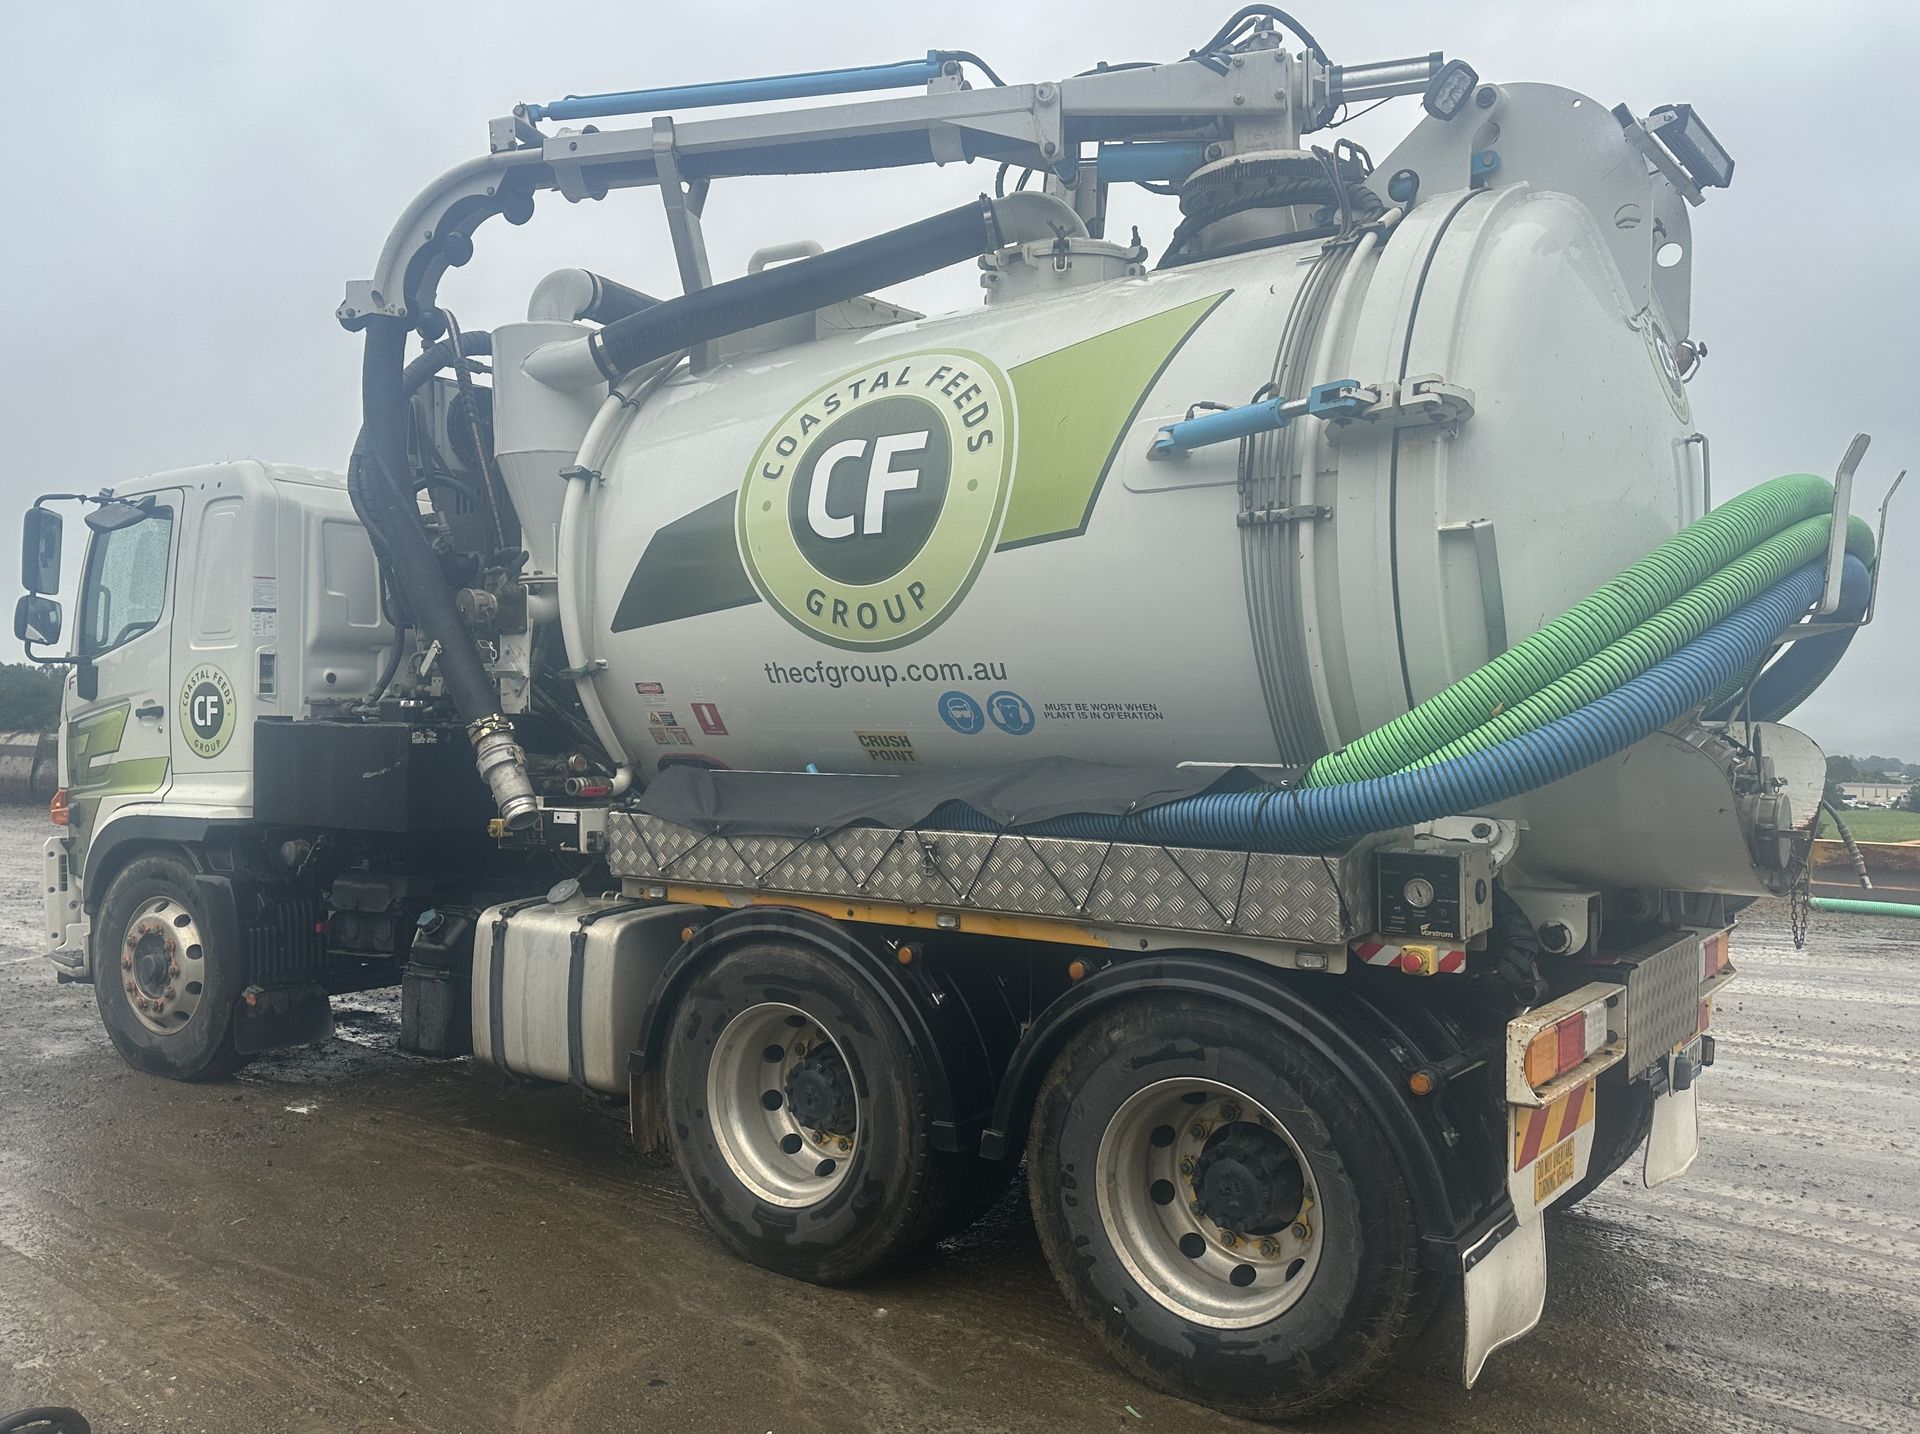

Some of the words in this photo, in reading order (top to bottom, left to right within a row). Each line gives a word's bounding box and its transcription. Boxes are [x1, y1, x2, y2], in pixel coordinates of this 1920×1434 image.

[762, 366, 911, 480] COASTAL
[925, 365, 993, 452] FEEDS
[806, 430, 930, 539] CF
[805, 581, 926, 630] GROUP
[182, 669, 210, 707] COASTAL
[212, 671, 232, 705] FEEDS
[764, 660, 1008, 689] thecfgroup.com.au
[193, 695, 219, 726] CF
[1043, 711, 1075, 720] PLANT
[1078, 711, 1088, 720] IS
[1089, 711, 1101, 720] IN
[1044, 703, 1072, 711] MUST
[1075, 703, 1089, 711] BE
[1090, 703, 1123, 711] WORN
[1124, 703, 1158, 711] WHEN
[194, 739, 221, 753] GROUP
[858, 734, 912, 748] CRUSH
[869, 750, 917, 762] POINT
